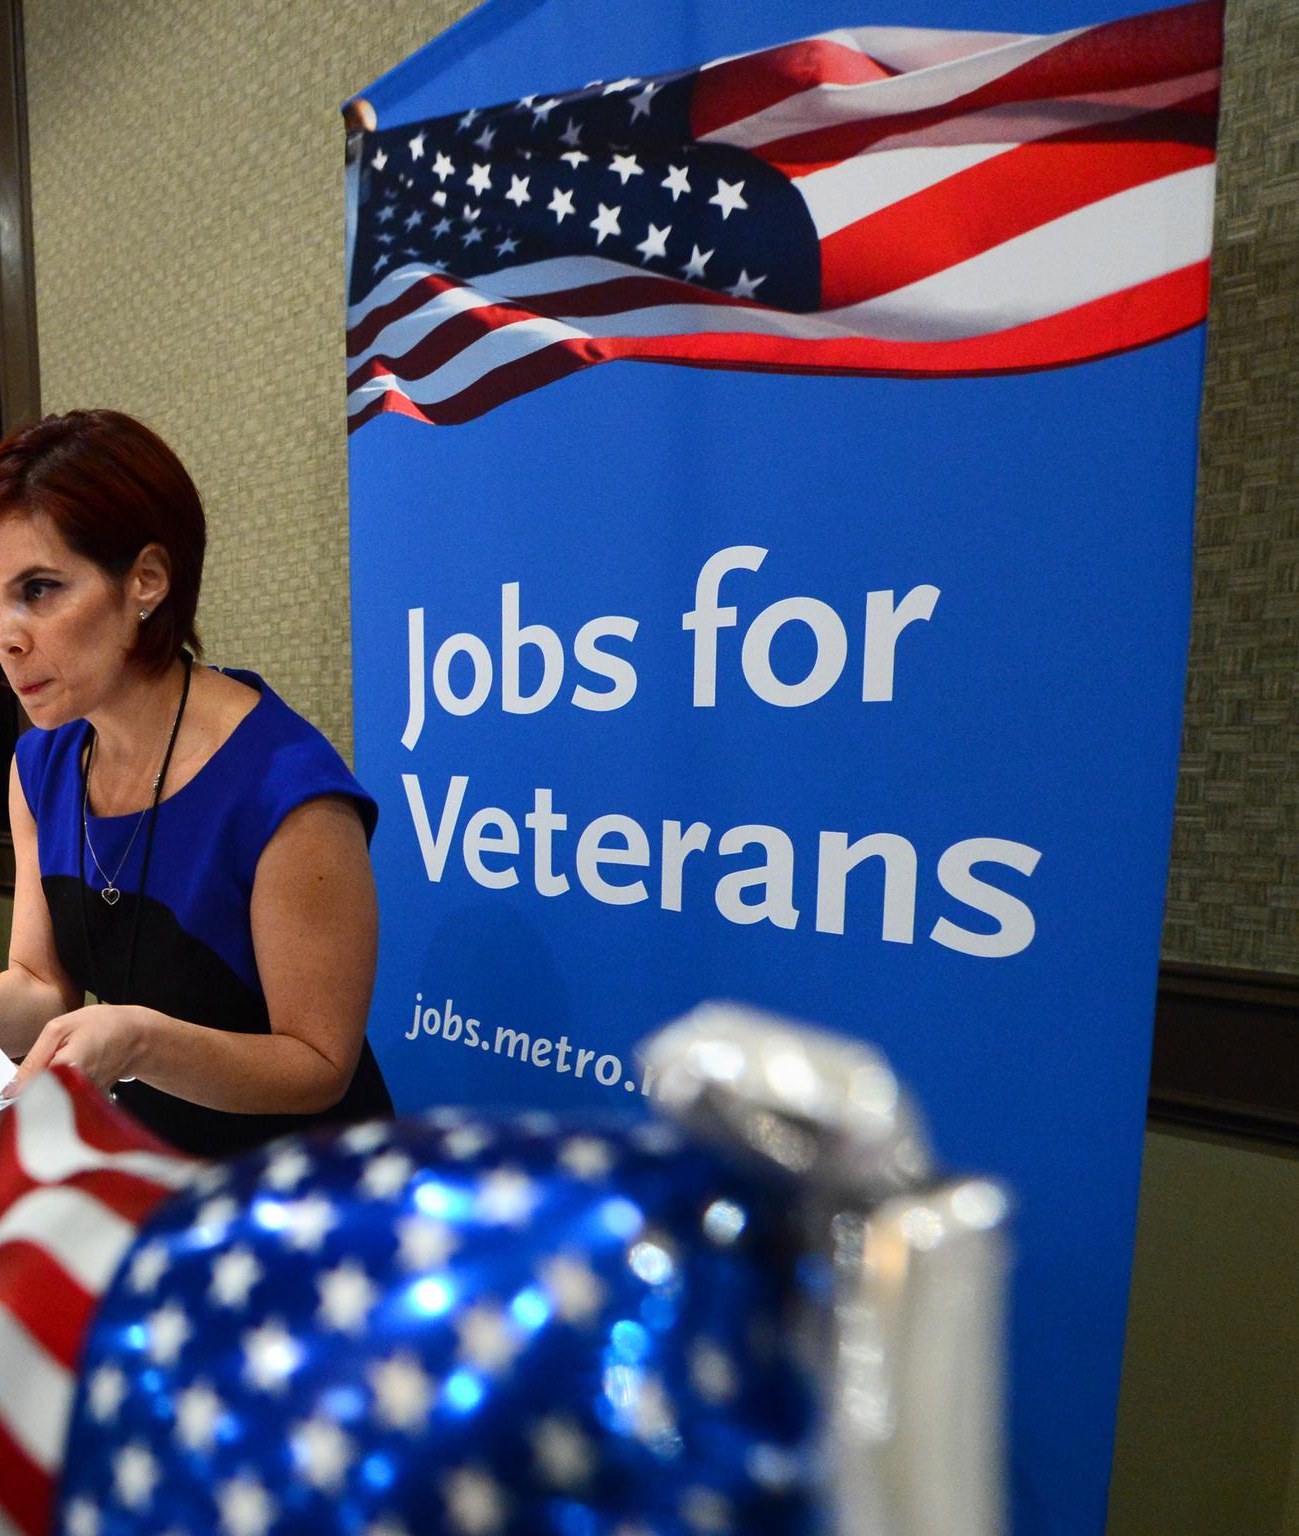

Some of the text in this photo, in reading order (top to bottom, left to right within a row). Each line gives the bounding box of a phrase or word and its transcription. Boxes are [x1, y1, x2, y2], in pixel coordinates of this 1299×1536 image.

[401, 545, 941, 752] Jobs for
[401, 774, 1043, 958] Veterans
